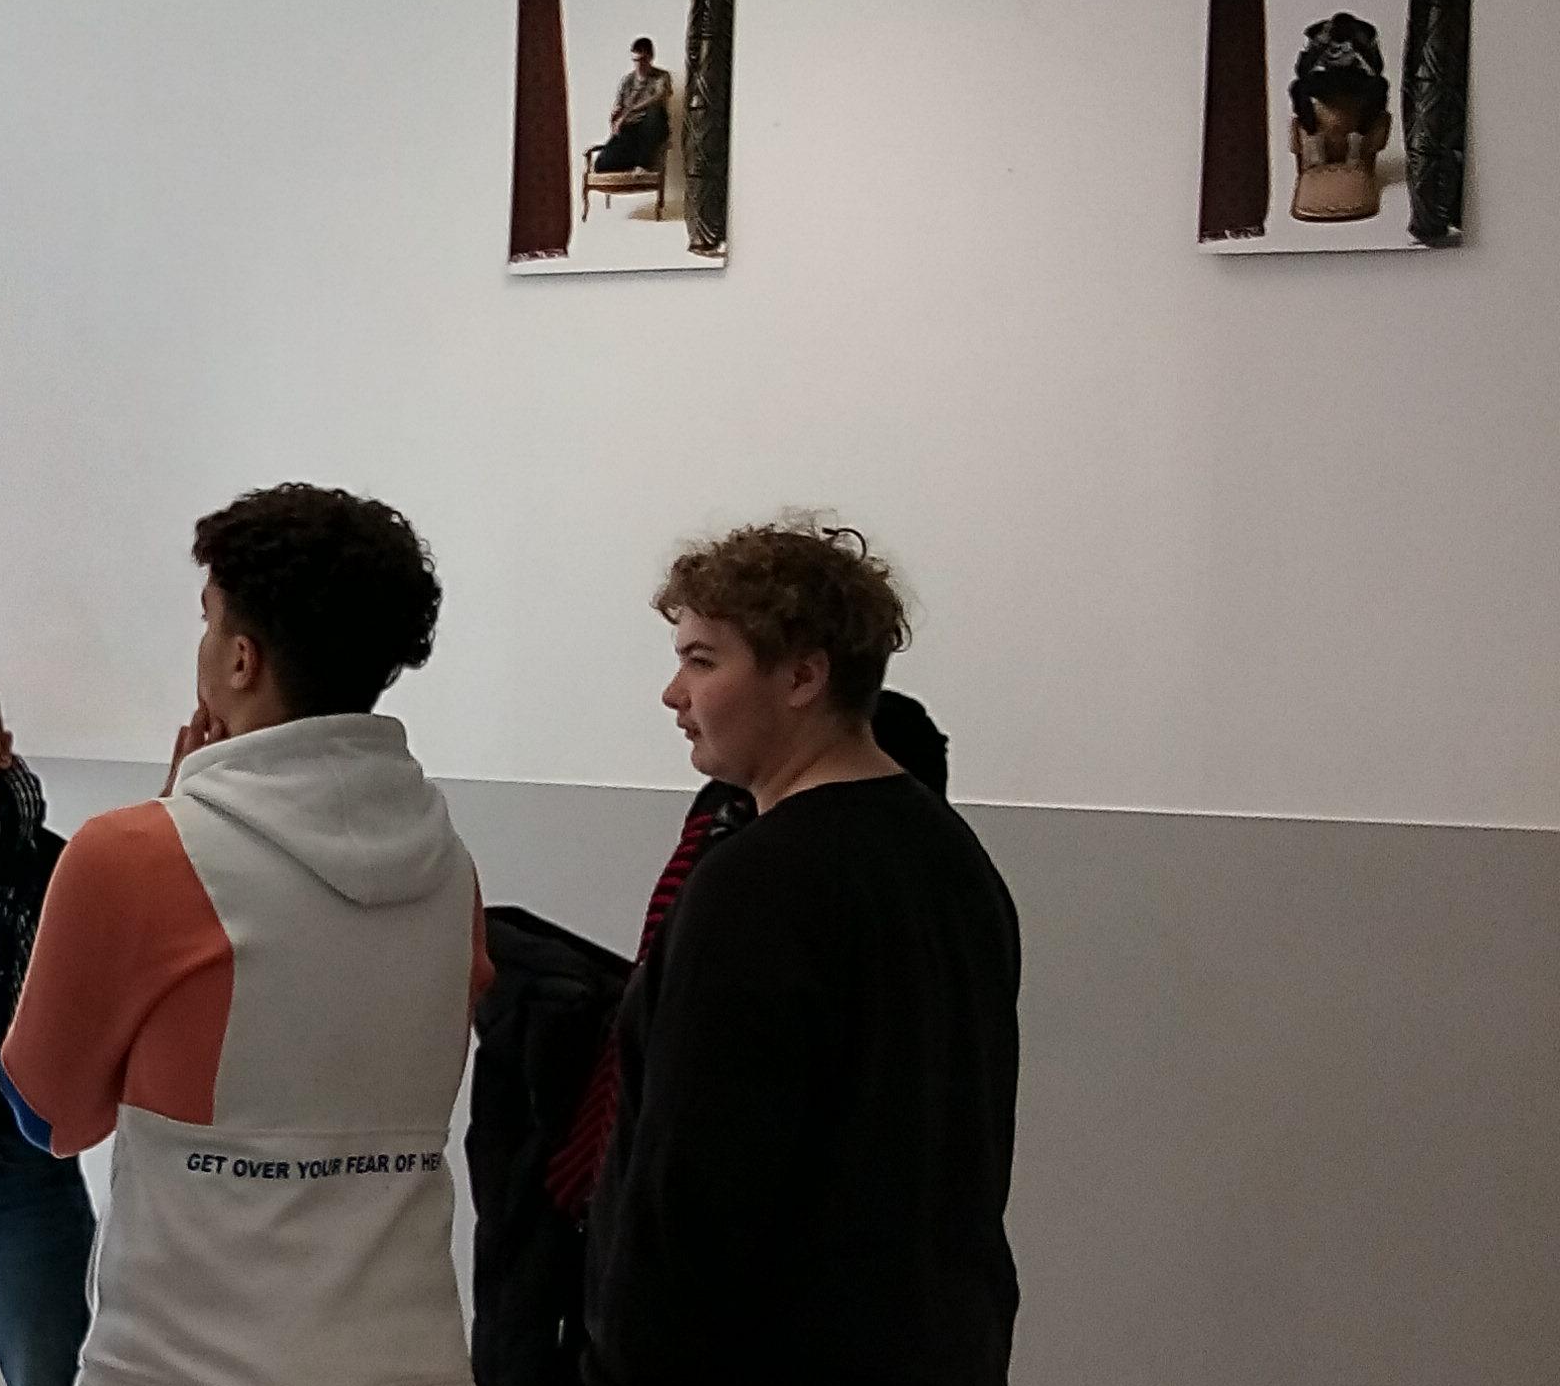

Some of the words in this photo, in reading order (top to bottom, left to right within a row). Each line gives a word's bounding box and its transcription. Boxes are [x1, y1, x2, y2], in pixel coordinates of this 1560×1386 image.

[187, 1153, 228, 1174] GET
[233, 1159, 290, 1179] OVER
[297, 1158, 341, 1179] YOUR
[346, 1154, 389, 1174] FEAR
[396, 1153, 416, 1173] OF
[421, 1153, 442, 1172] HE
